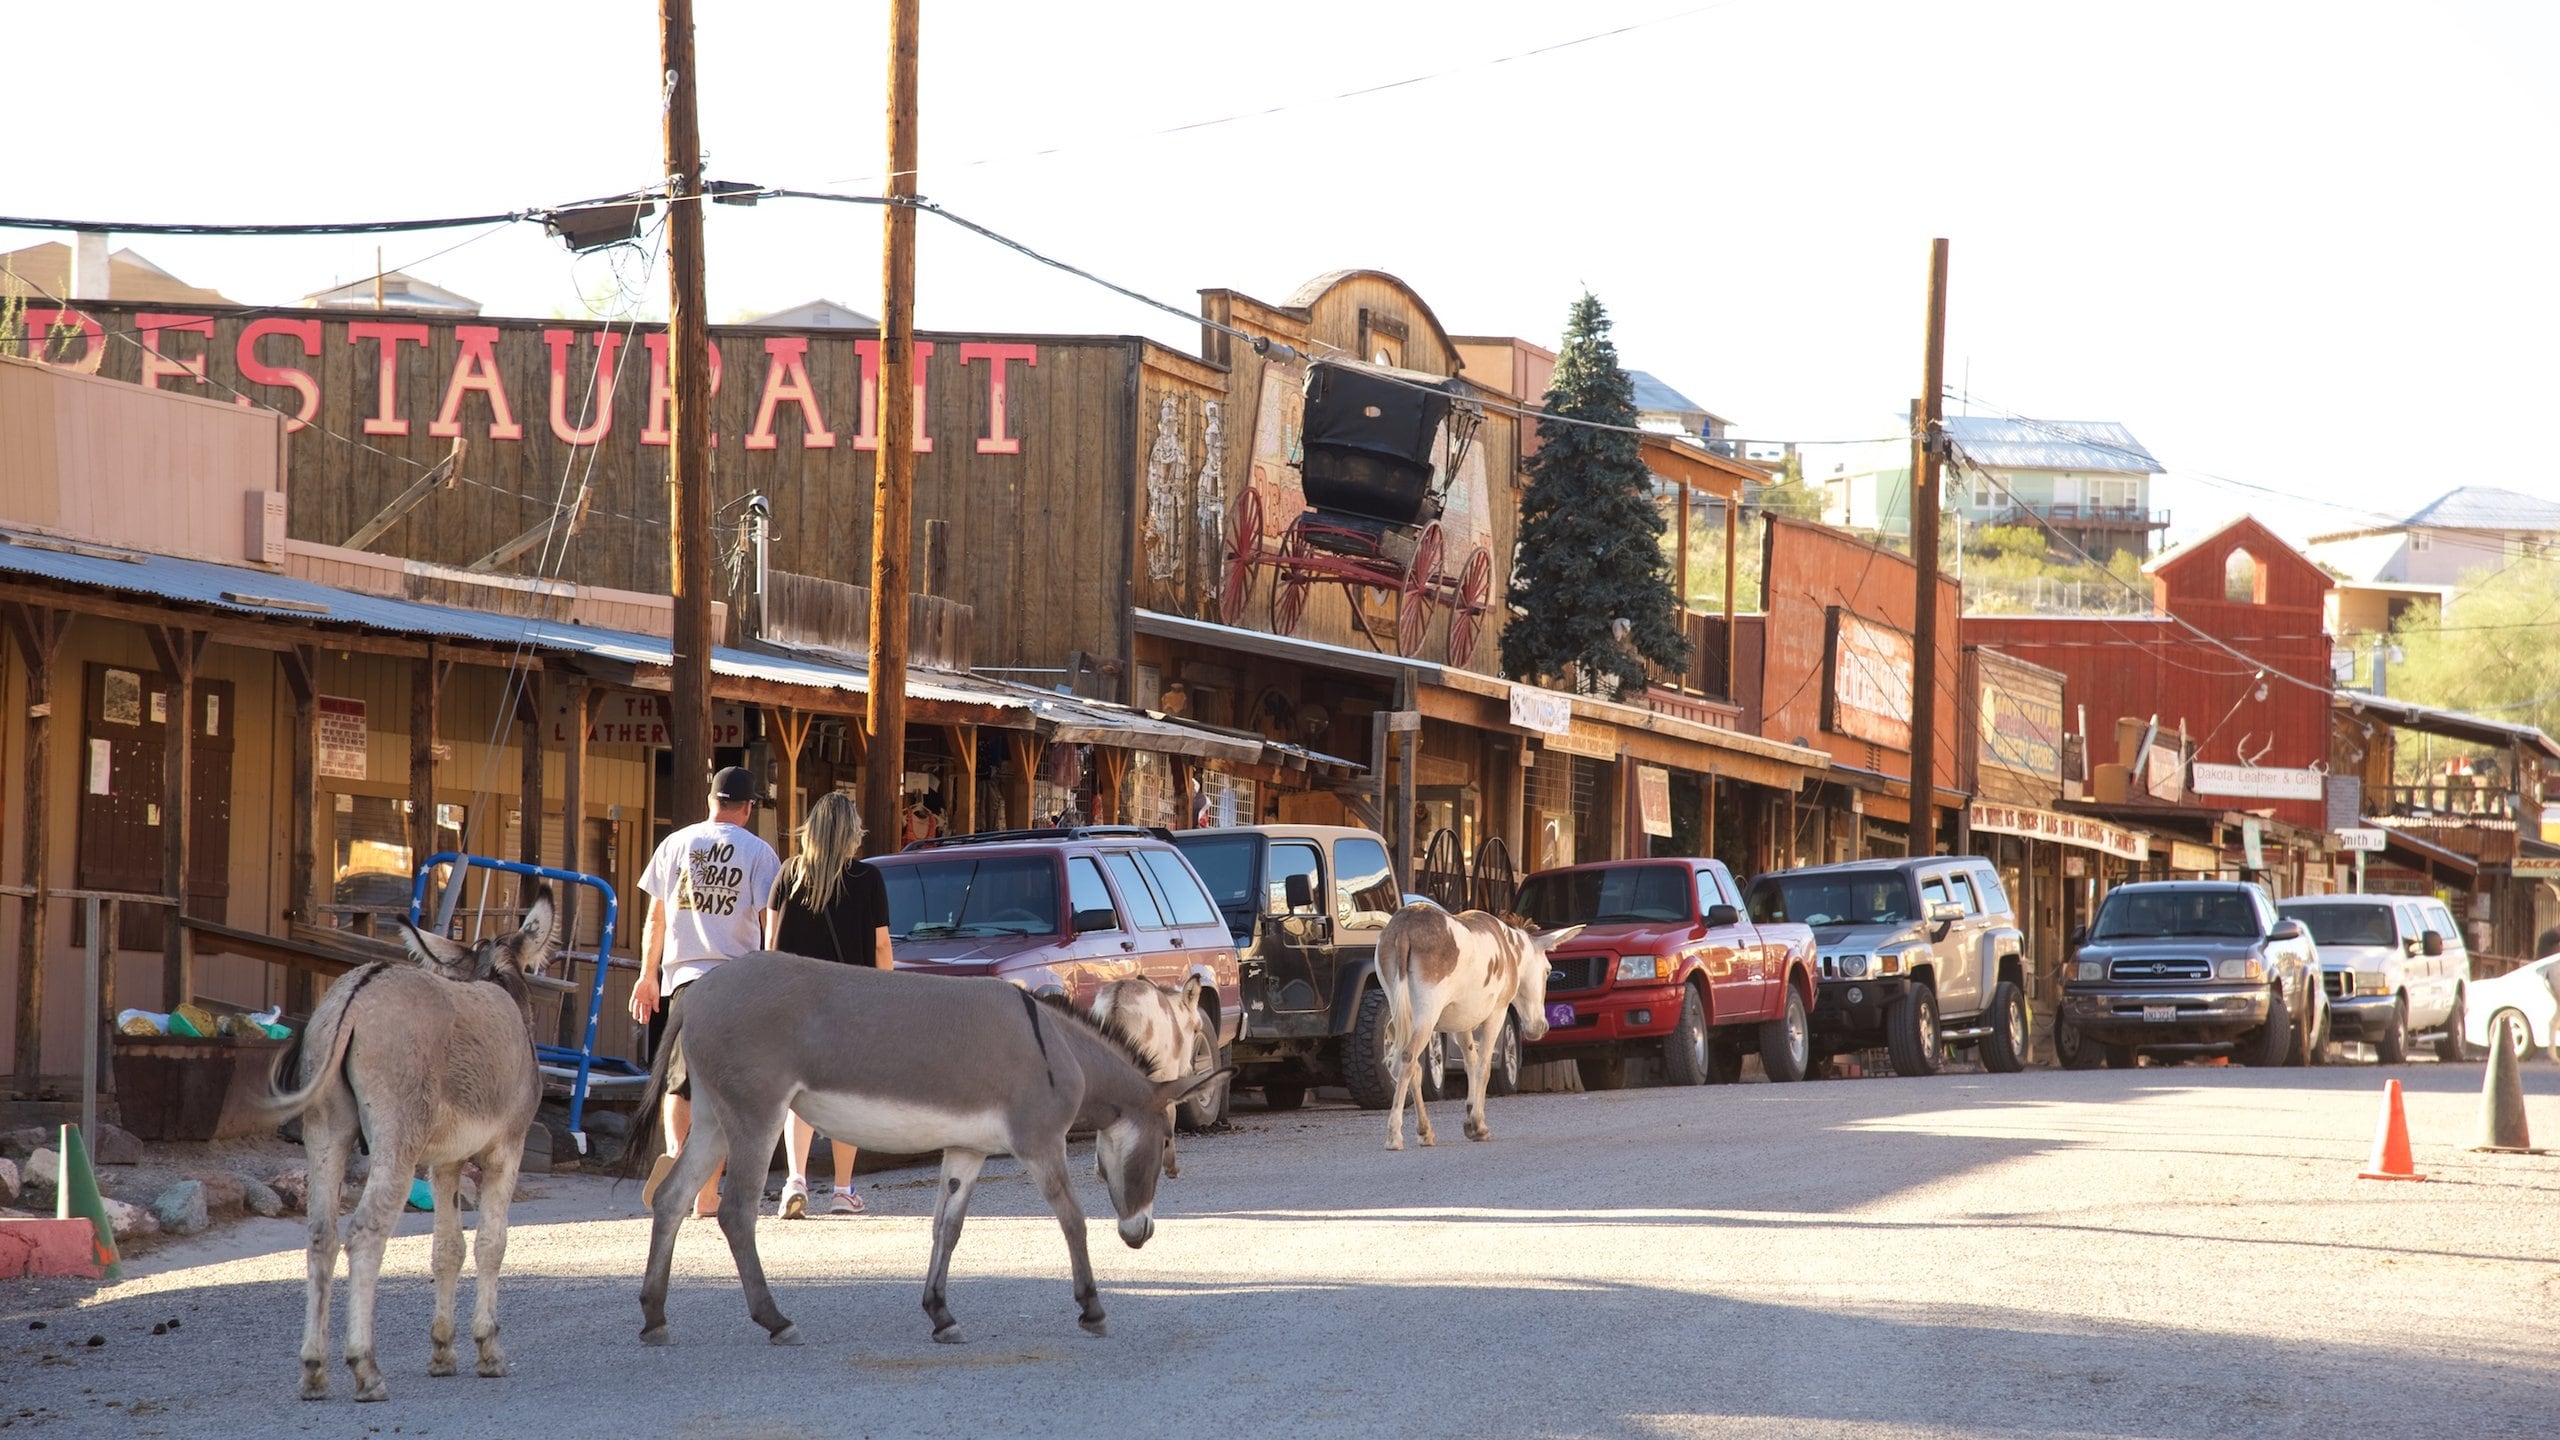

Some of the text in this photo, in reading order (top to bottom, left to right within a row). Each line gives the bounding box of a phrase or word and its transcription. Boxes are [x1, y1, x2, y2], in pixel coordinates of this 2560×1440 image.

[555, 724, 663, 742] LATHER
[2196, 766, 2320, 786] Dakota Leather & Gifts
[707, 843, 735, 863] NO
[705, 865, 743, 888] BAD
[694, 892, 738, 916] DAYS
